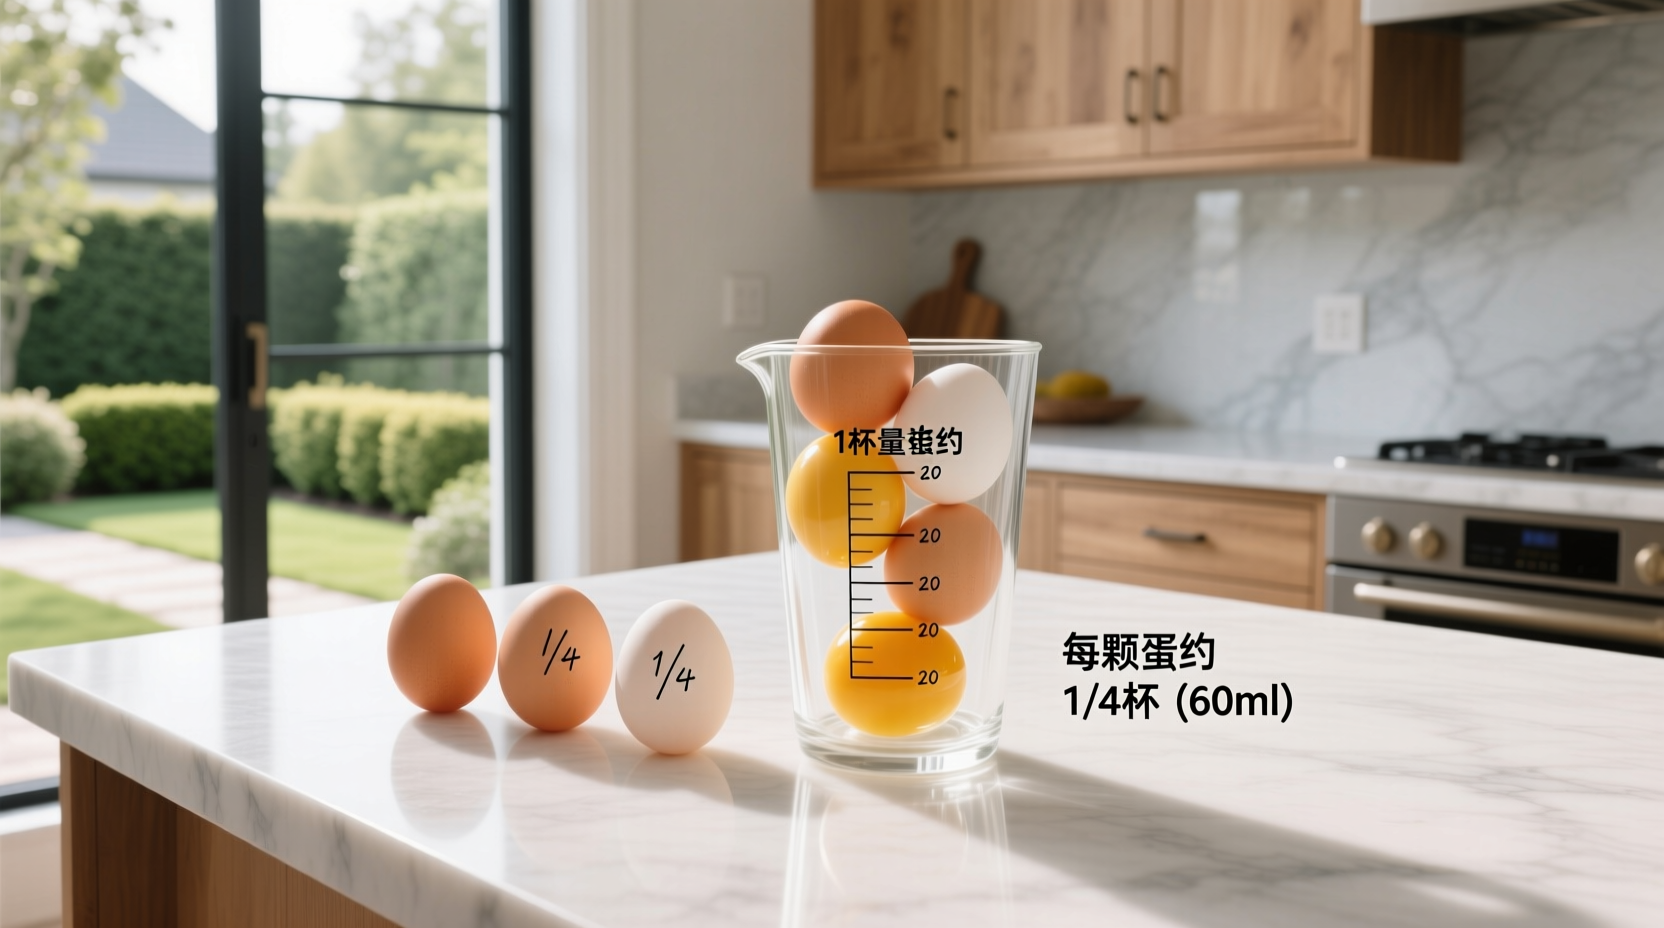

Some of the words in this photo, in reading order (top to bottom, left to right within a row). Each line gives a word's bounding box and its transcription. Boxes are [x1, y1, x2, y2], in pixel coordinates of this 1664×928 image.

[920, 465, 942, 480] 20
[919, 528, 941, 543] 20
[918, 576, 941, 591] 20
[918, 623, 939, 638] 20
[541, 628, 581, 676] 1/4
[652, 643, 696, 701] 1/4
[917, 670, 939, 685] 20
